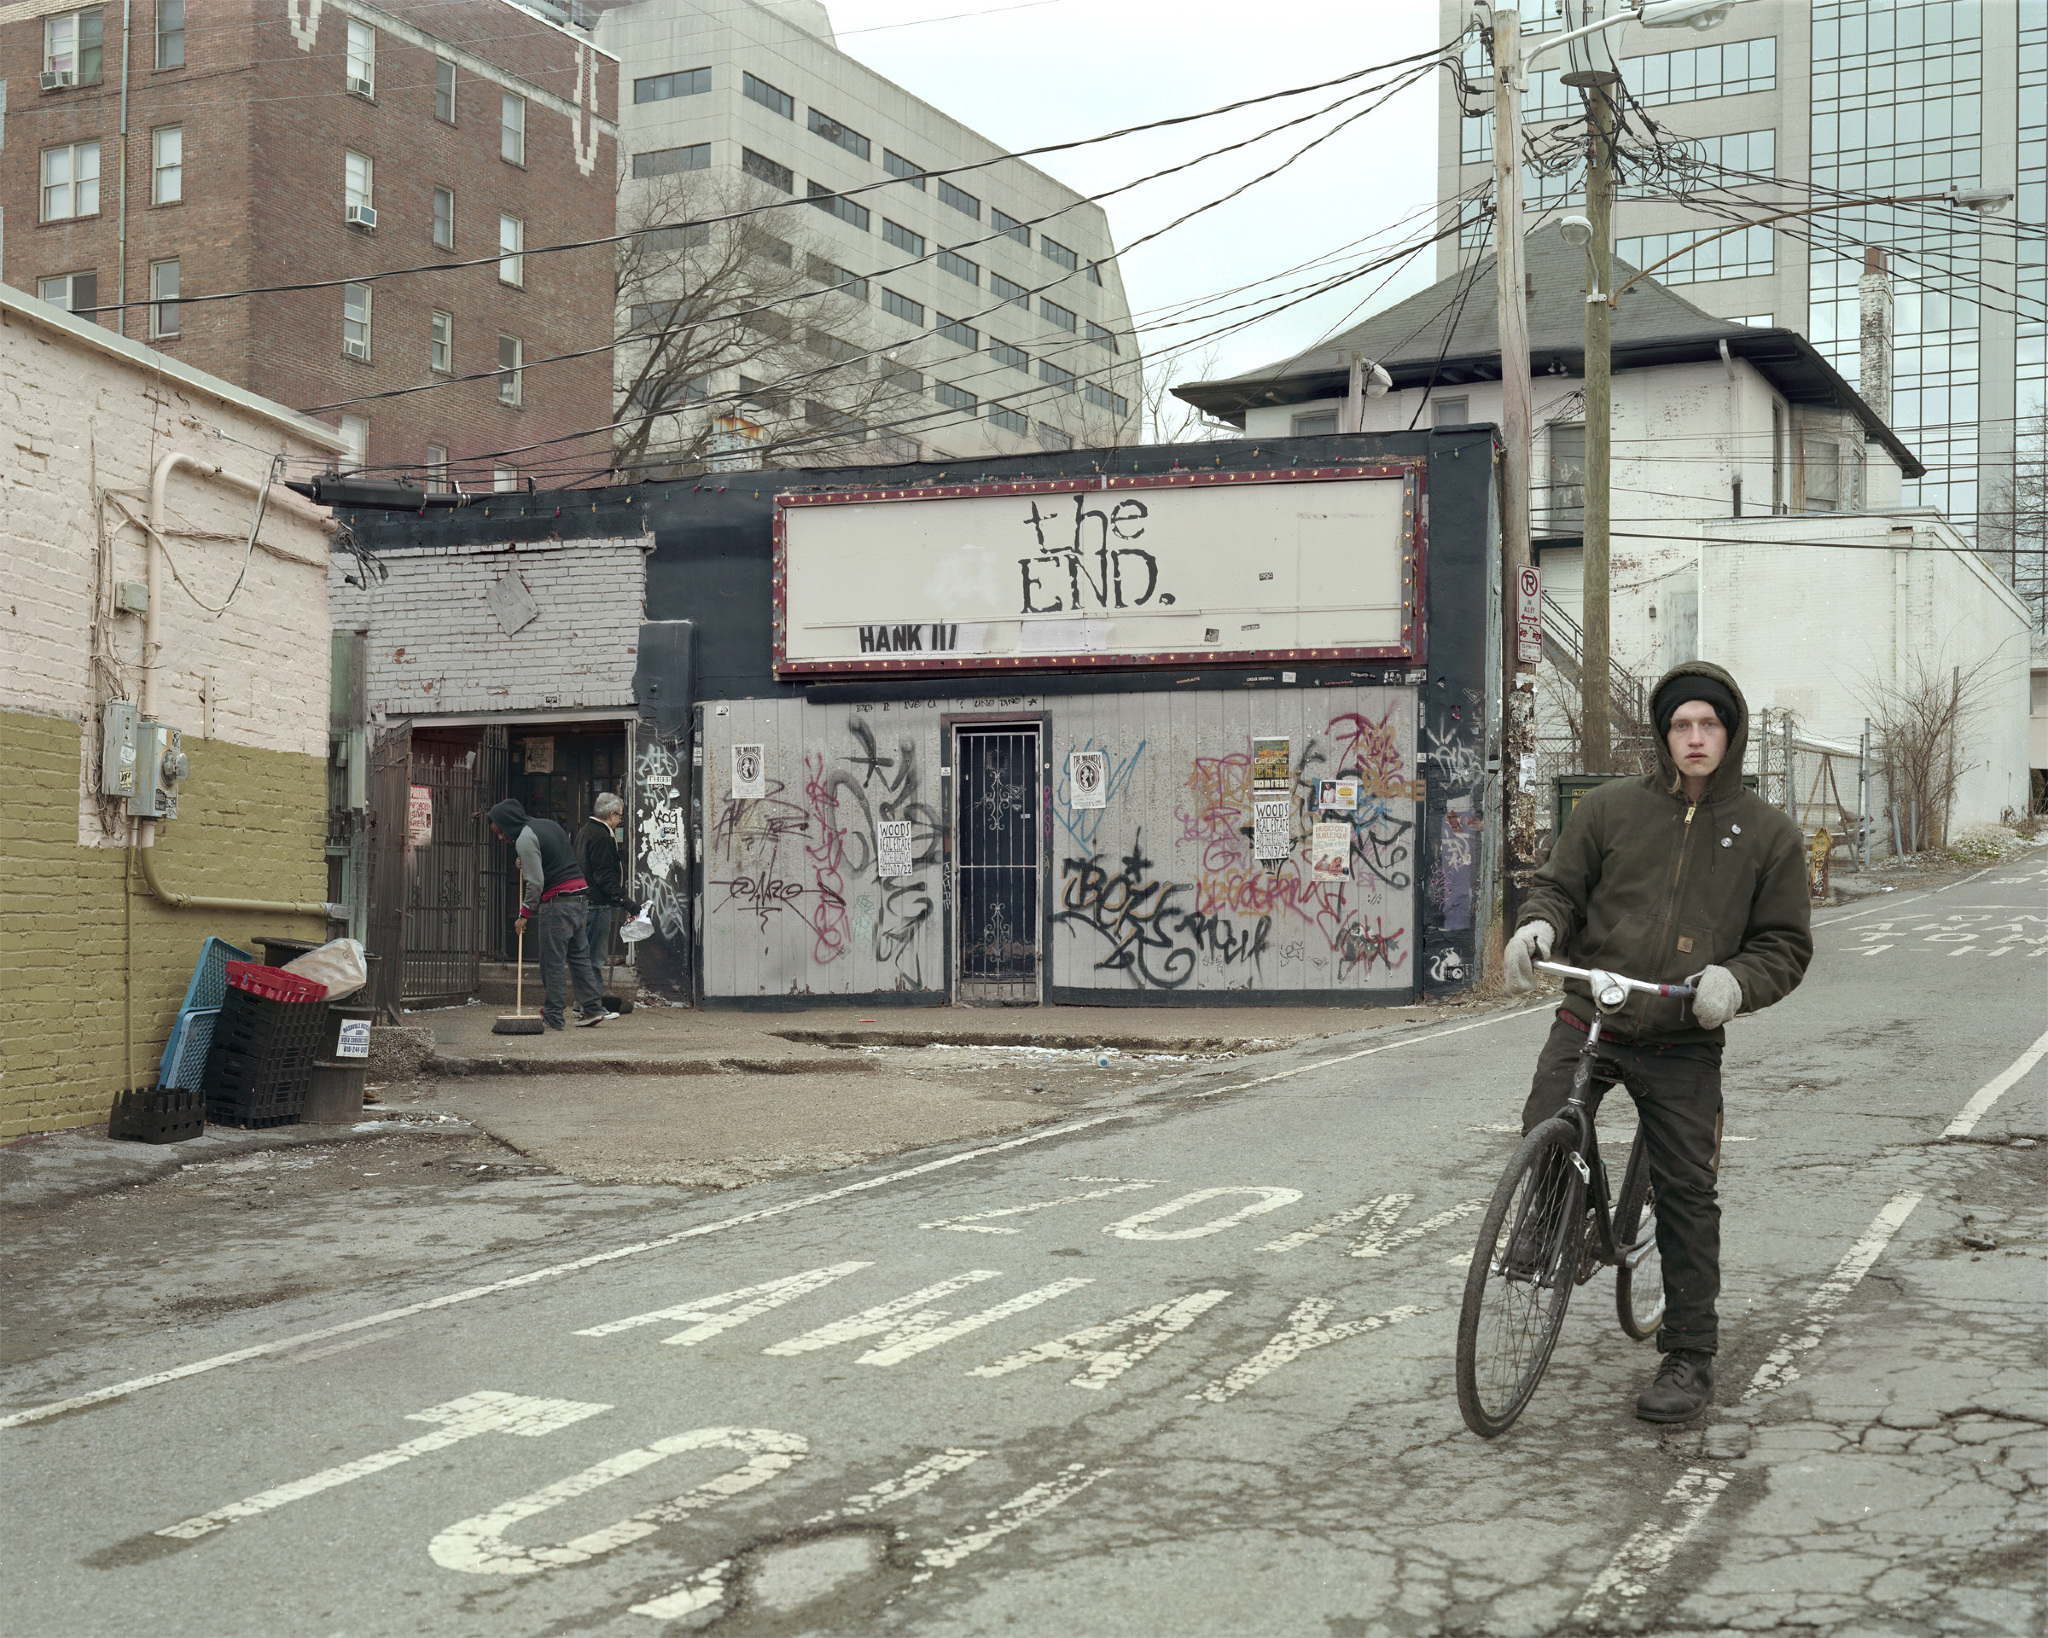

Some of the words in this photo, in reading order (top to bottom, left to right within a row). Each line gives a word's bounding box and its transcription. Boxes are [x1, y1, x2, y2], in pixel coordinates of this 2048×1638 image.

[1024, 494, 1149, 556] the
[859, 624, 923, 653] HANK
[1256, 803, 1289, 817] WOODS
[880, 822, 910, 836] WOODS
[1256, 819, 1269, 832] REAL
[1271, 818, 1289, 832] ESTATE
[1274, 846, 1290, 857] 3/22
[897, 864, 912, 874] 3/22
[572, 1260, 1435, 1402] AWAY
